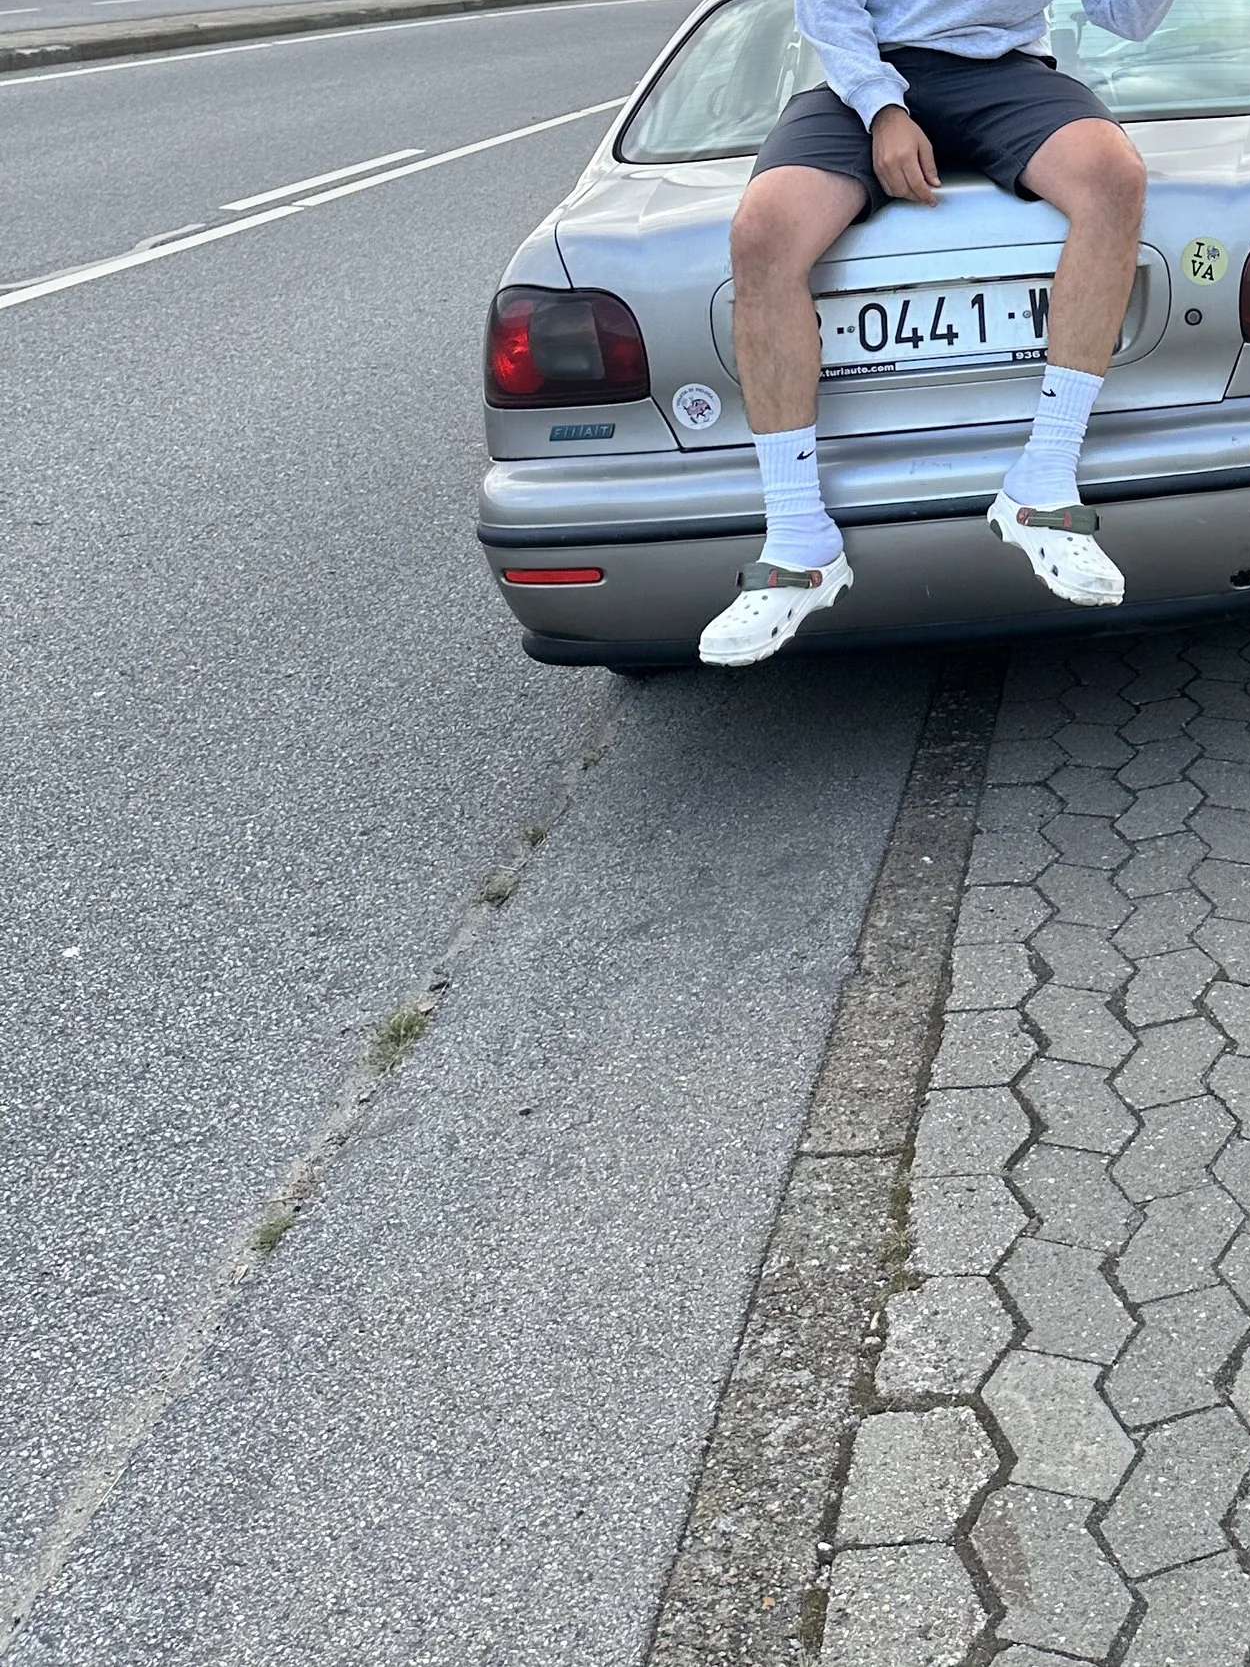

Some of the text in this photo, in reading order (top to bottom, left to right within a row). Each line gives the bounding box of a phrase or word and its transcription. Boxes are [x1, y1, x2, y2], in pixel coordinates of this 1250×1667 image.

[1193, 241, 1205, 258] I
[1191, 259, 1215, 281] VA
[820, 364, 895, 378] .turiauto.com
[1015, 350, 1041, 360] 936
[554, 425, 609, 438] FIAT
